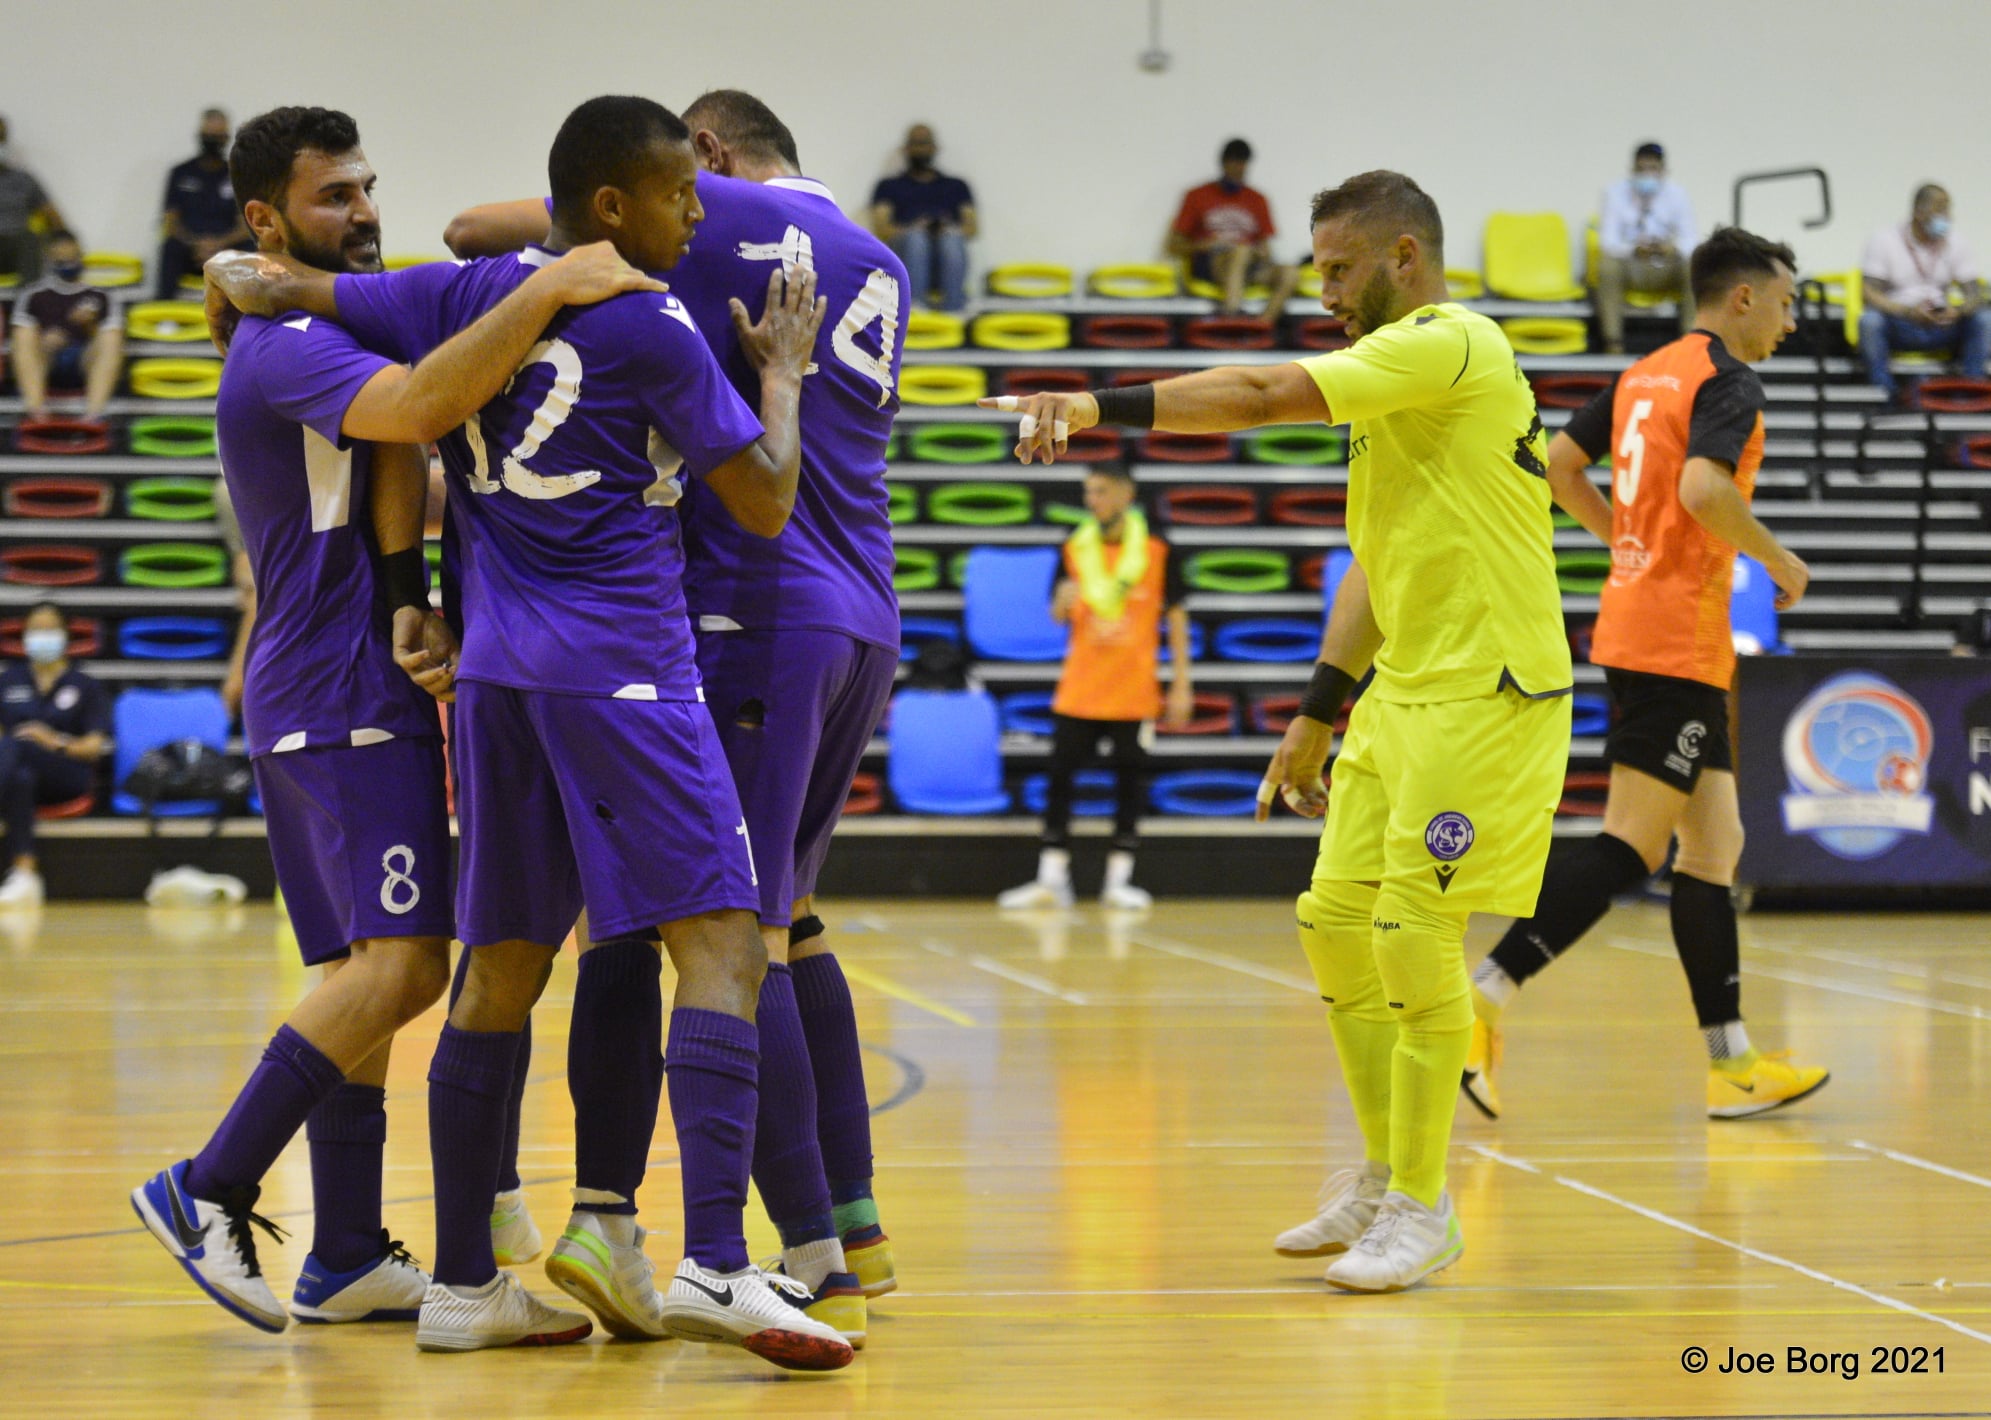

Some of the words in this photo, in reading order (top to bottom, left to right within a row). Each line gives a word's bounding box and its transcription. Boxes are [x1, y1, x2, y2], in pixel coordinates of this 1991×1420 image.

[464, 336, 602, 500] 12
[1616, 400, 1653, 507] 5
[381, 844, 420, 915] 8
